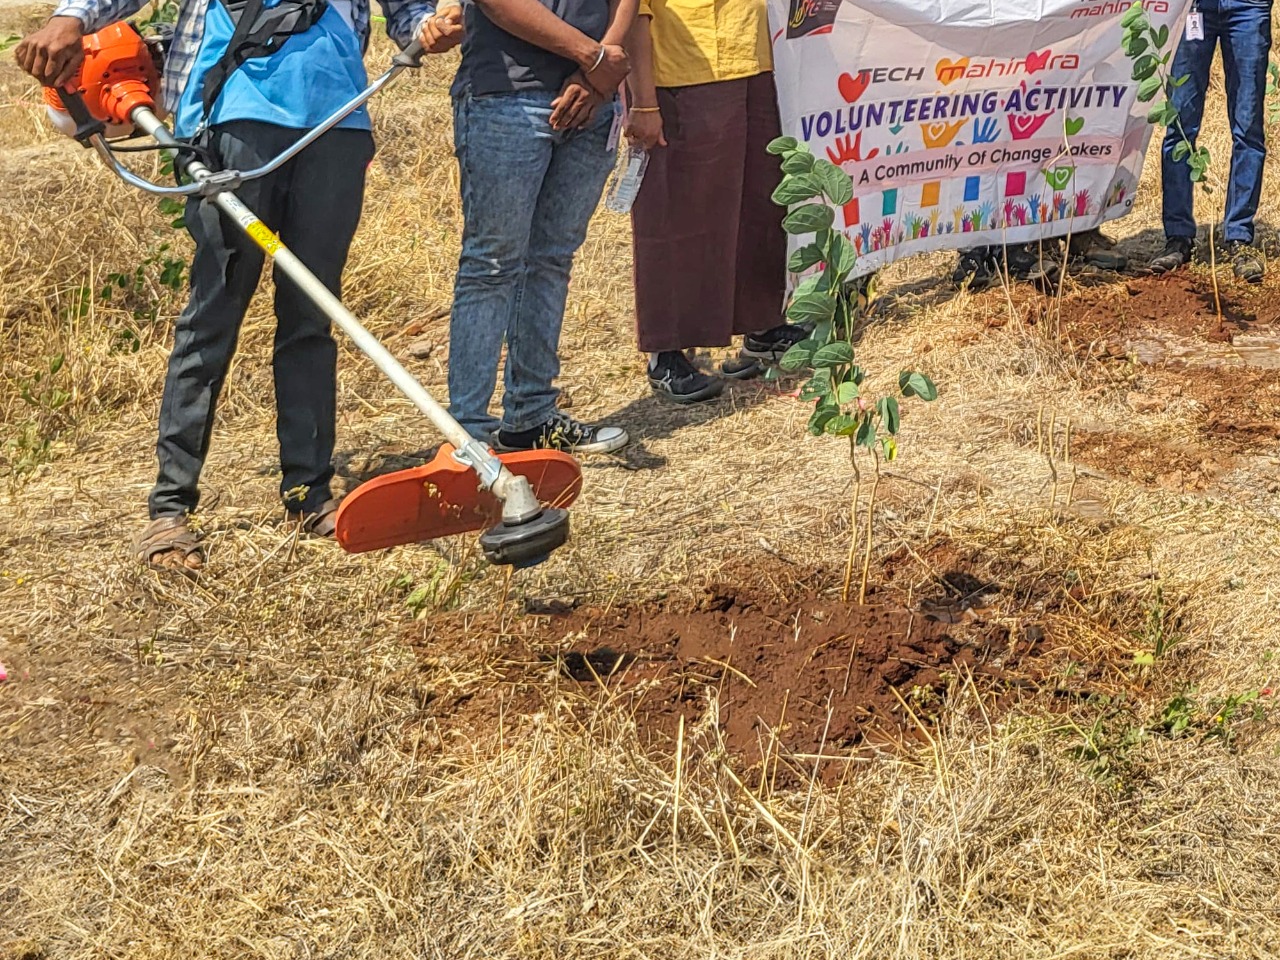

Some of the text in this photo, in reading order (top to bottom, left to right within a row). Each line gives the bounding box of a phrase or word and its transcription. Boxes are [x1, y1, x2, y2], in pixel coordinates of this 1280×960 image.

[857, 66, 925, 85] TECH
[800, 85, 1129, 142] VOLUNTEERING ACTIVITY
[858, 168, 870, 186] A
[874, 153, 964, 182] Community
[967, 149, 987, 165] Of
[990, 146, 1052, 164] Change
